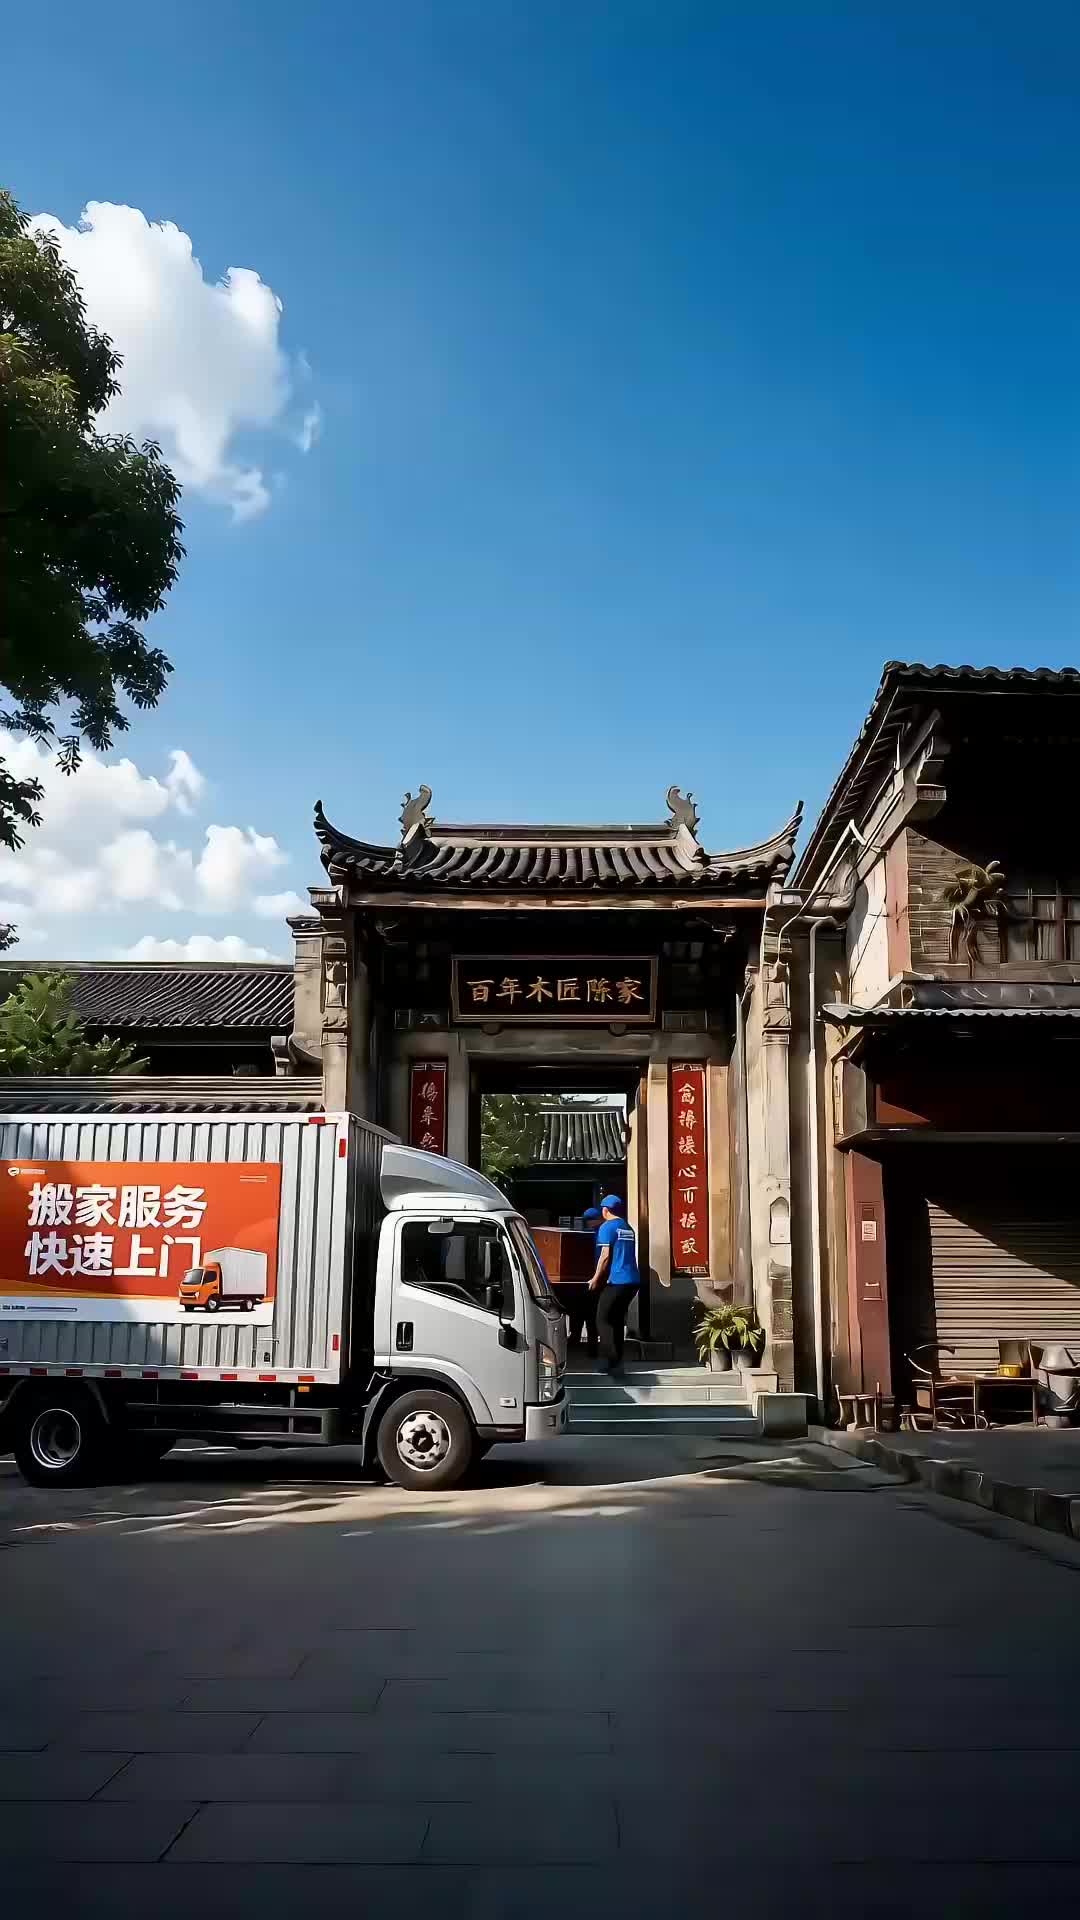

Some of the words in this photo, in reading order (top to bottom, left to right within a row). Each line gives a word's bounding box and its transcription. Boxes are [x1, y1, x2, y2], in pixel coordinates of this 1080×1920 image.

[27, 1182, 207, 1228] 搬家服务
[24, 1231, 202, 1277] 快速上门
